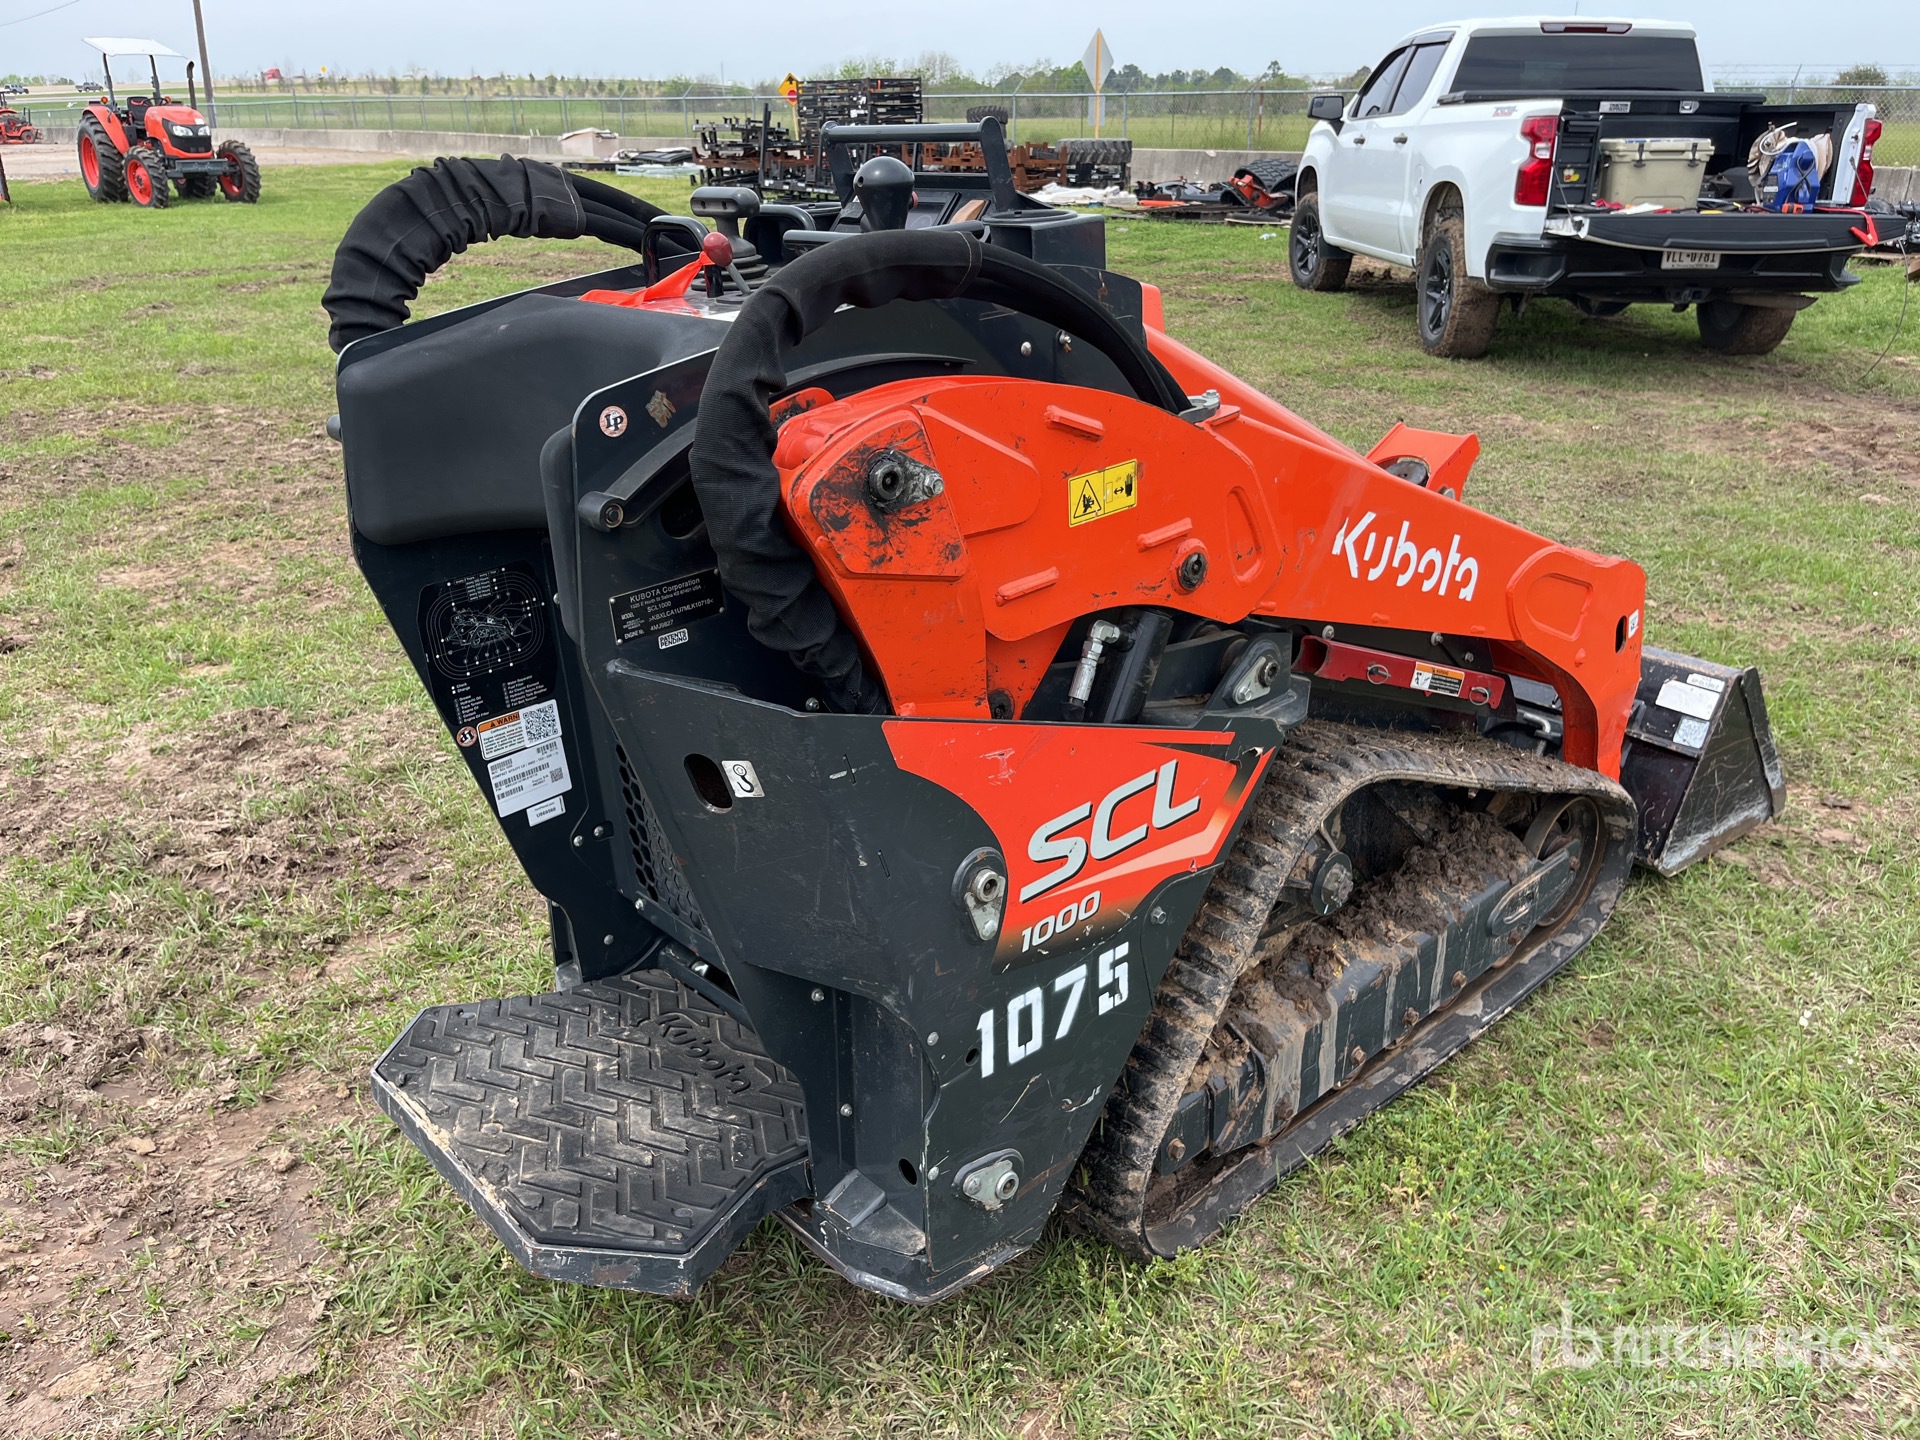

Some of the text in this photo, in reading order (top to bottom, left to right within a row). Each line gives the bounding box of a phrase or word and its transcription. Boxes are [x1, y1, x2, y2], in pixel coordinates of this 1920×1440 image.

[1332, 511, 1478, 601] Kubota
[621, 612, 634, 620] MODEL
[630, 578, 700, 603] KUBOTA Corporation
[661, 636, 687, 648] PENDING
[1019, 759, 1200, 902] SCL
[1022, 890, 1101, 953] 1000
[976, 942, 1129, 1078] 1075
